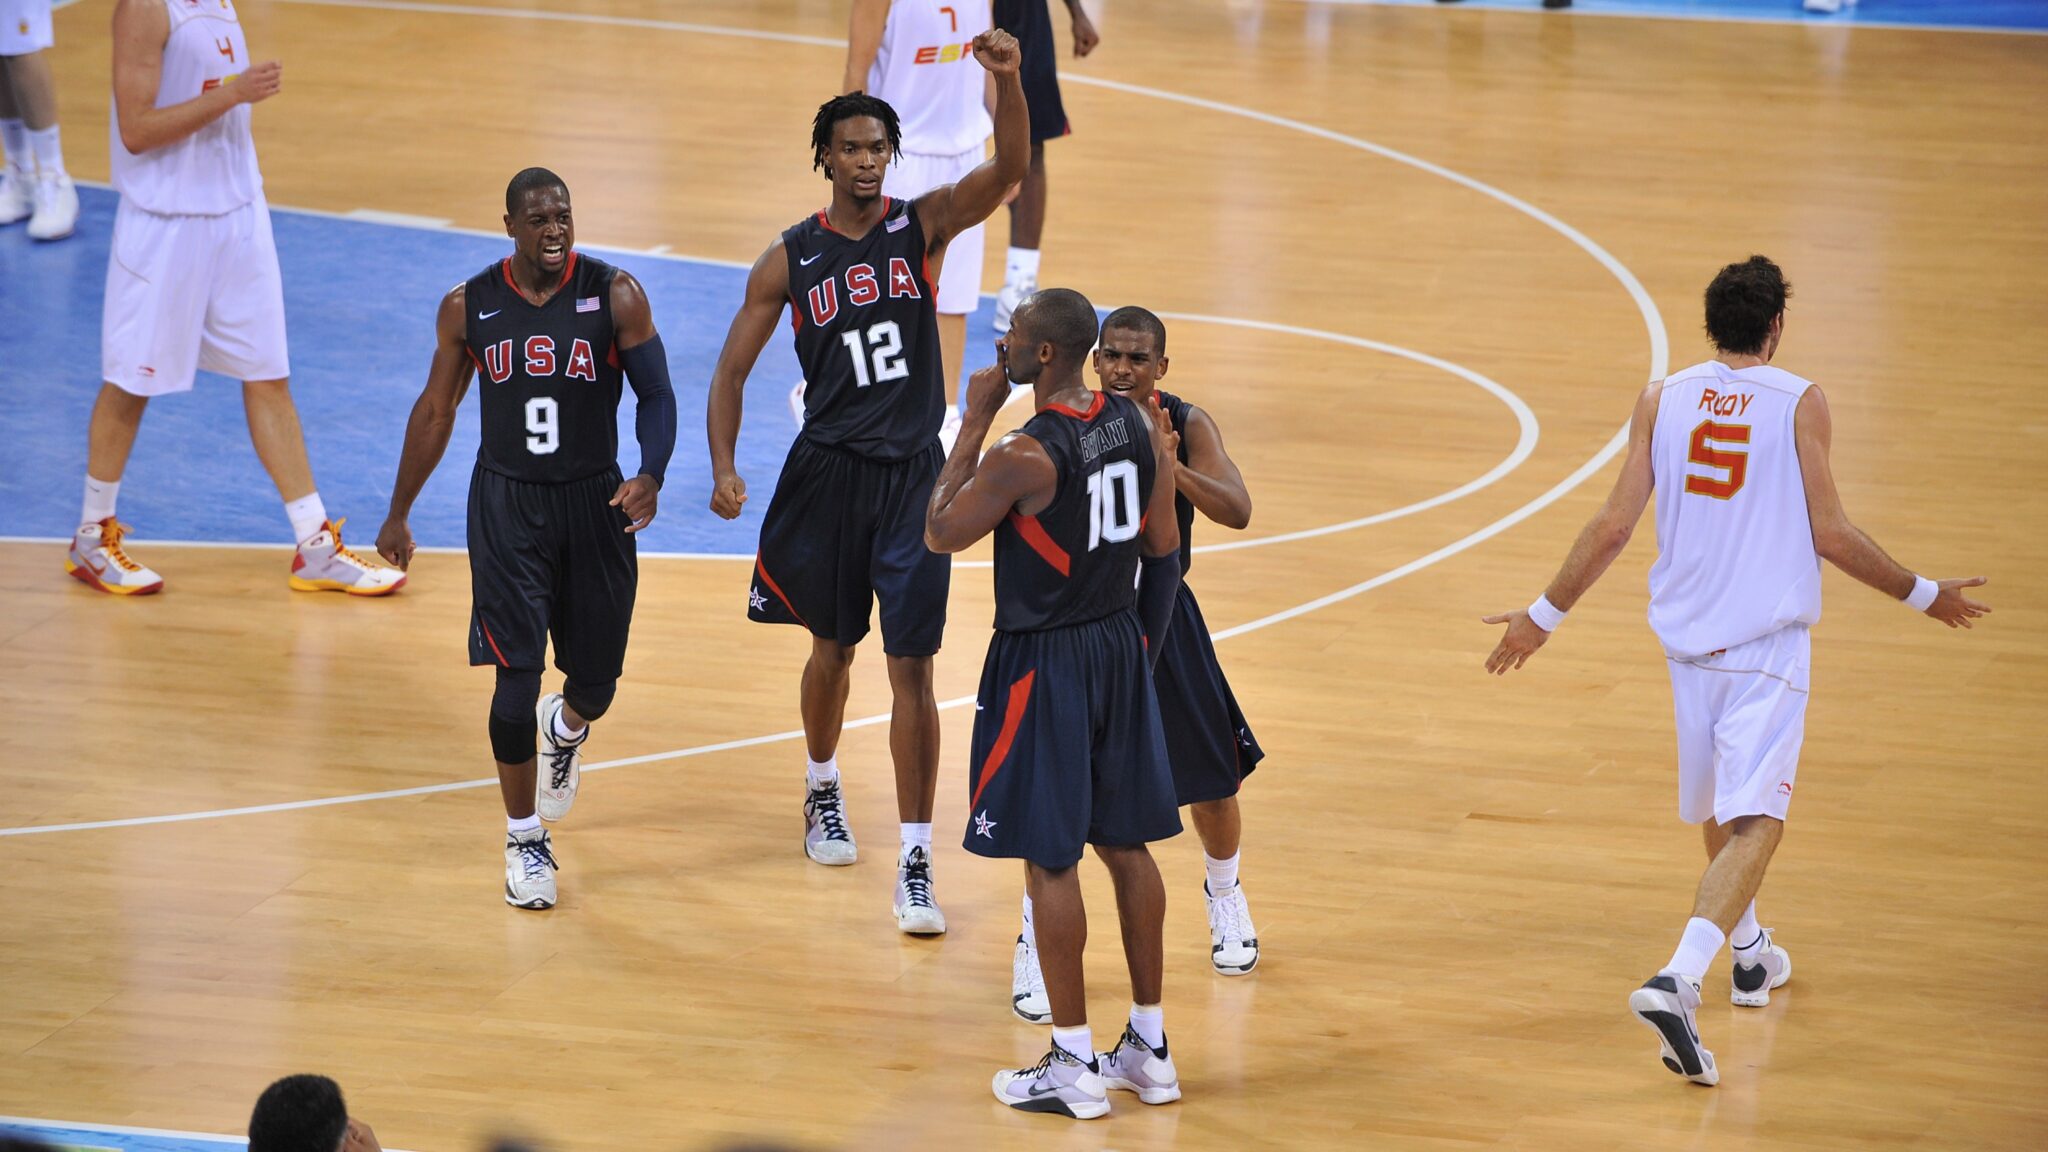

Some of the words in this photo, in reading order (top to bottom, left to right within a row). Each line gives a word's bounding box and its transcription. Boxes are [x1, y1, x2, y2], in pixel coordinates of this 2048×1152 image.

[215, 36, 235, 63] 4
[940, 6, 957, 32] 7
[808, 257, 922, 327] USA
[485, 335, 596, 384] USA
[841, 320, 909, 388] 12
[524, 396, 560, 455] 9
[1684, 419, 1752, 501] 5
[1086, 459, 1141, 552] 10
